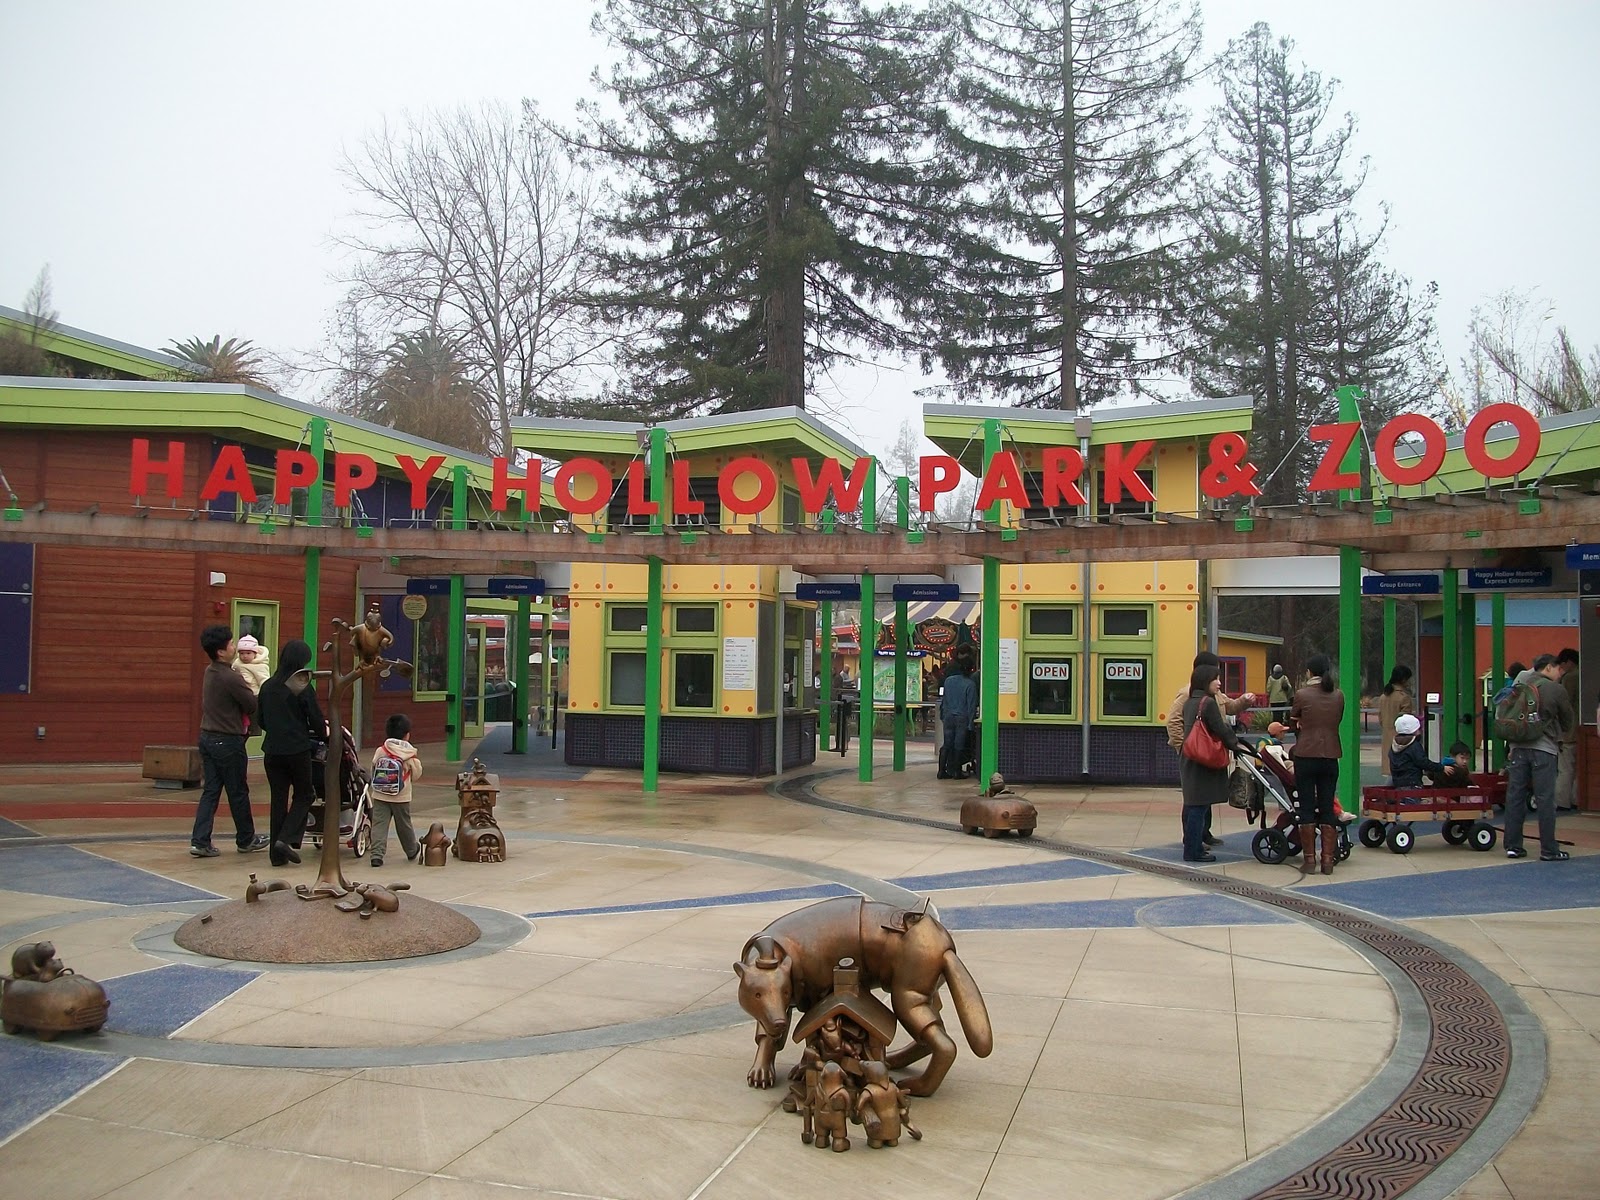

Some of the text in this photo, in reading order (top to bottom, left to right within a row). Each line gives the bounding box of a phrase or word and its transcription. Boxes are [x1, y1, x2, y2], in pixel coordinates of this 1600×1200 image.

[130, 402, 1541, 515] HAPPY HOLLOW PARK & ZOO
[1582, 553, 1600, 561] Mem
[1475, 571, 1493, 580] Happy
[1034, 666, 1067, 677] OPEN
[1107, 666, 1141, 677] OPEN
